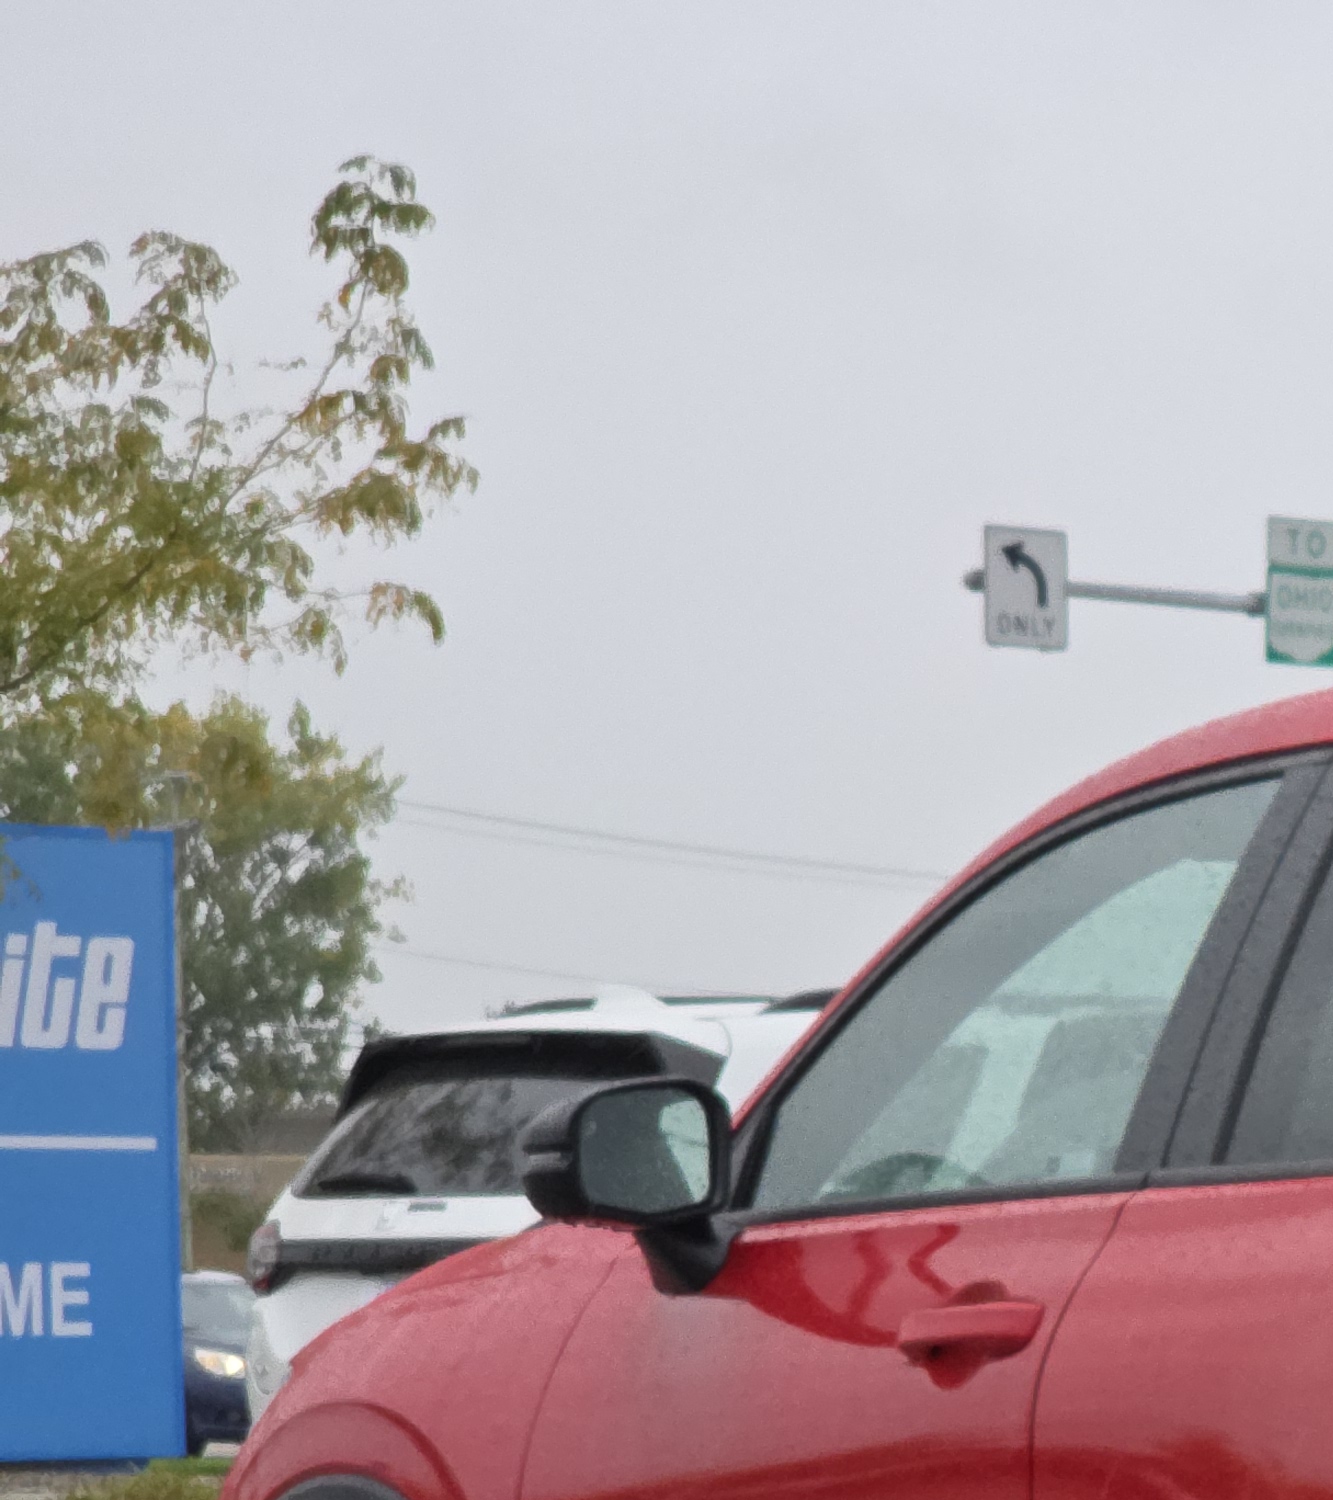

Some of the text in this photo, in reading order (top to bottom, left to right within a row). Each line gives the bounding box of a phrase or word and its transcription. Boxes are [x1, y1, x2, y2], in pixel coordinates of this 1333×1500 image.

[1287, 528, 1327, 559] TO
[1276, 584, 1333, 612] OHIO
[996, 613, 1056, 637] ONLY
